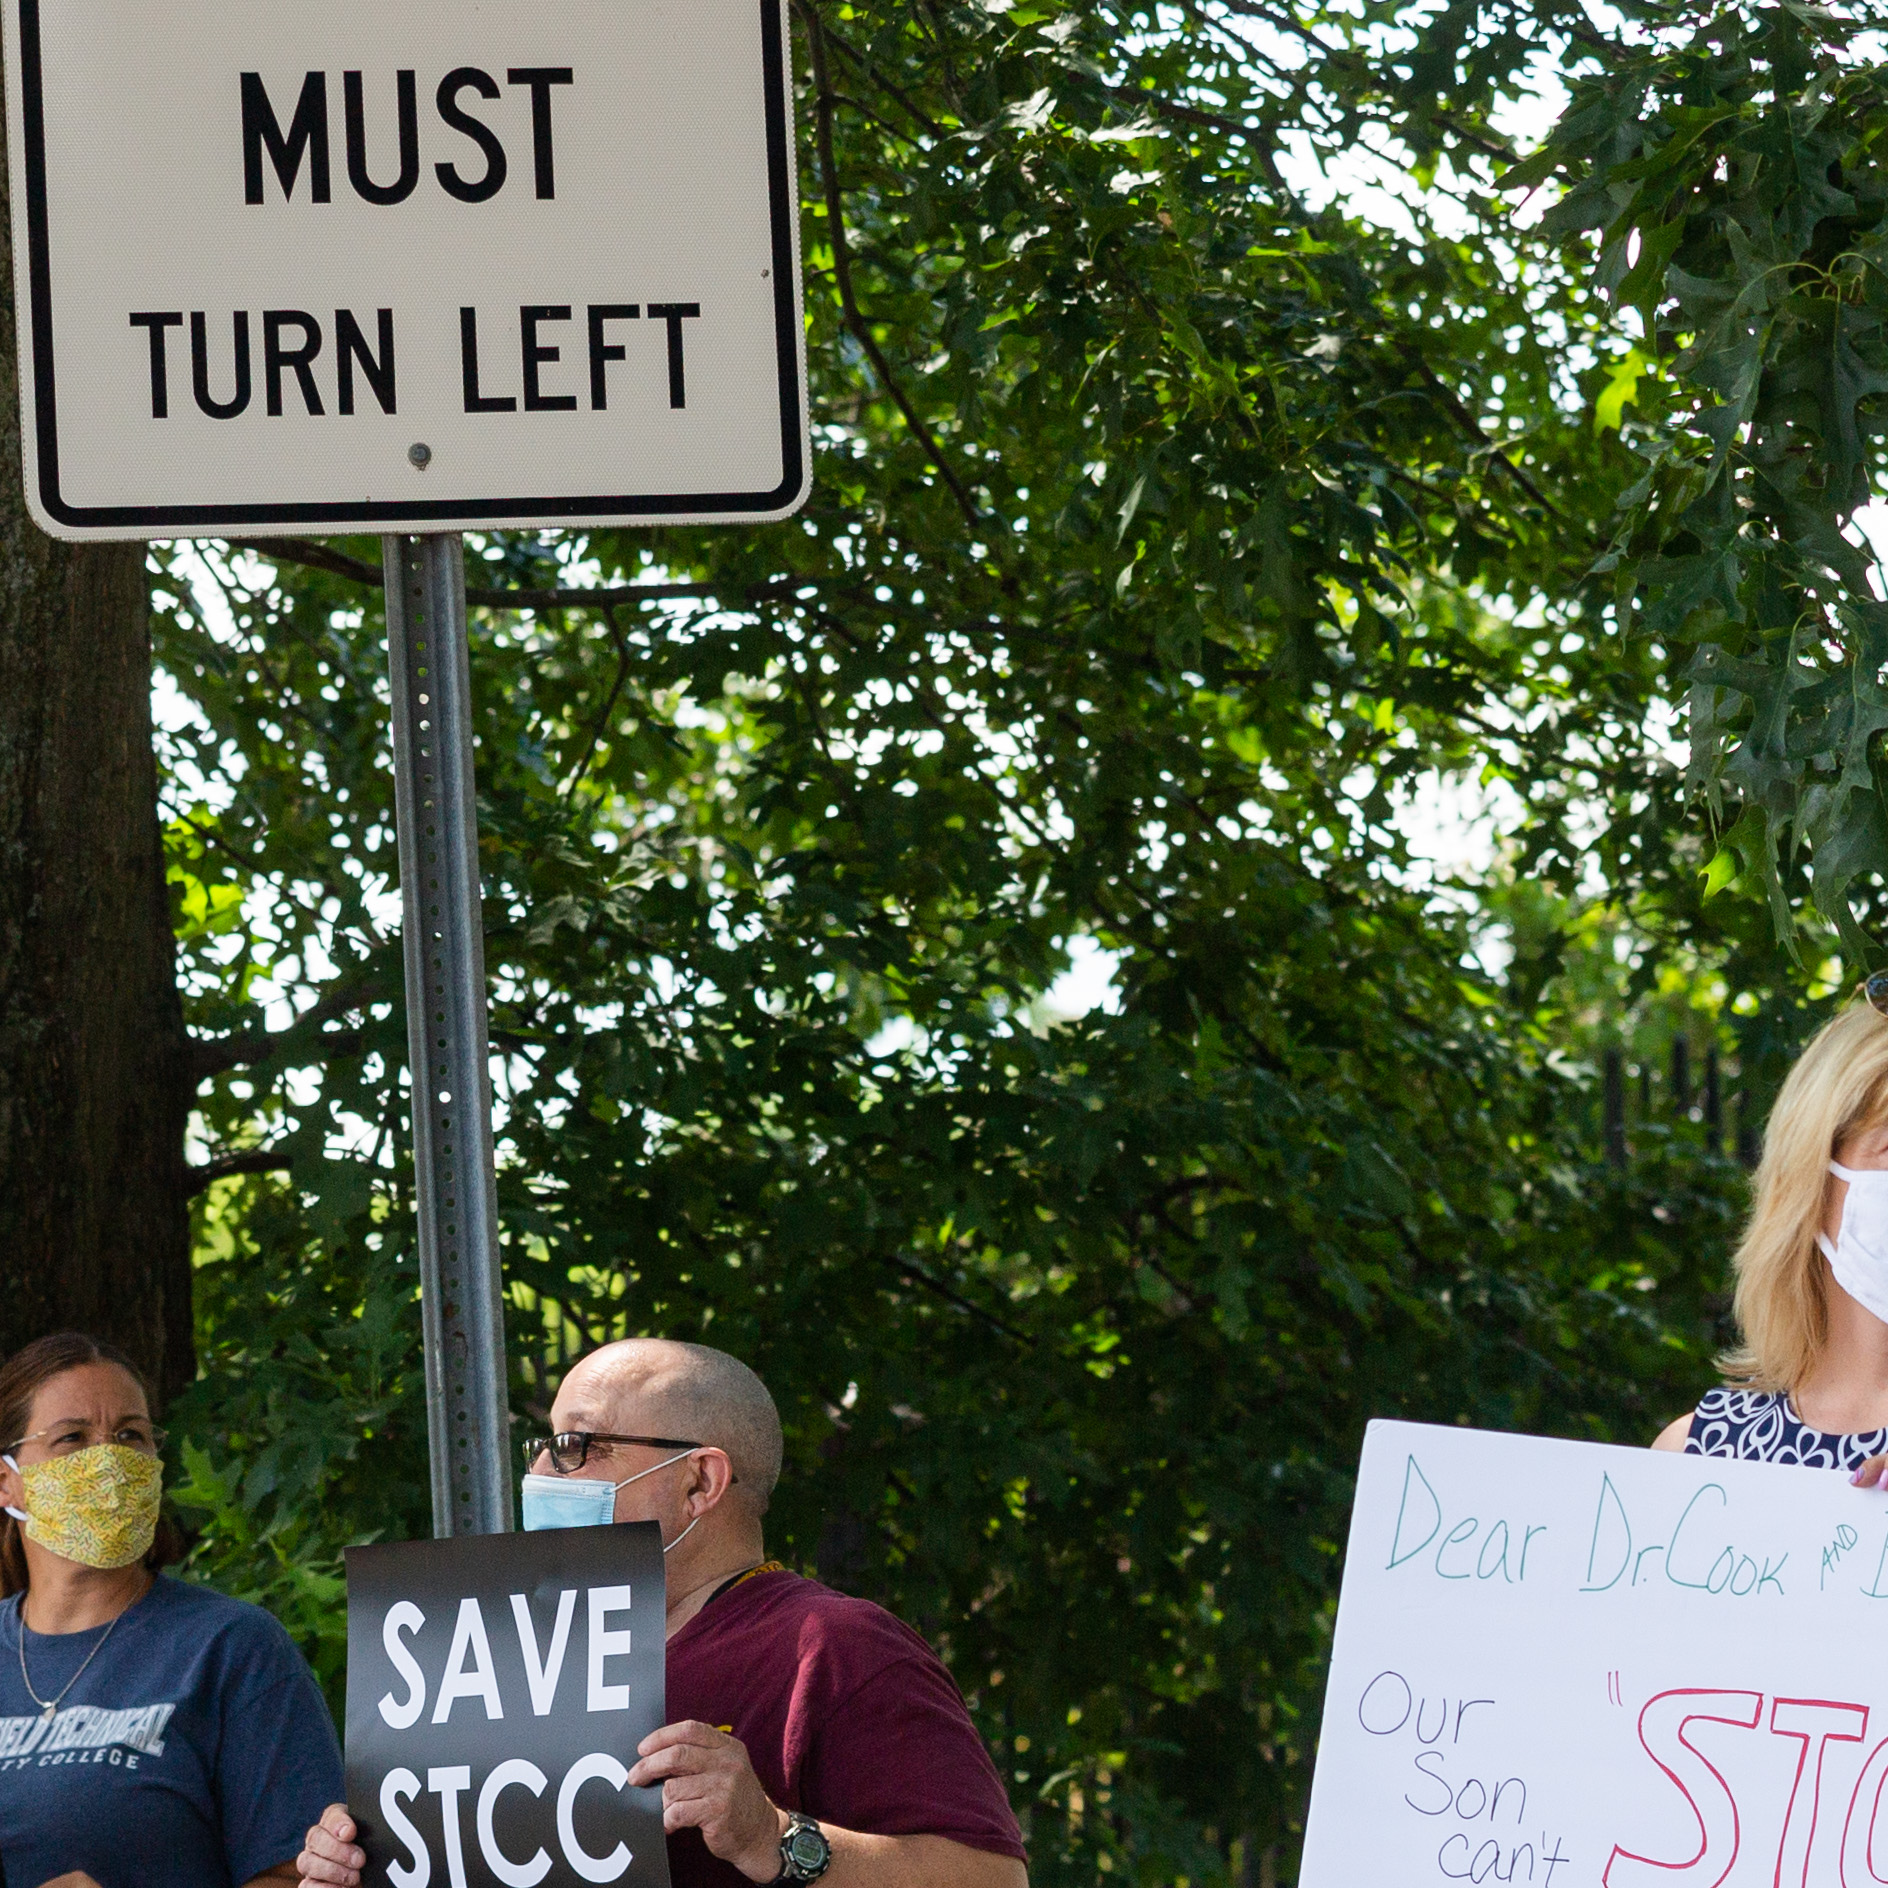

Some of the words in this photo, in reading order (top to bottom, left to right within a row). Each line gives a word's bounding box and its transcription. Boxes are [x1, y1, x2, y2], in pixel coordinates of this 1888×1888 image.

[240, 67, 573, 205] MUST
[129, 308, 396, 419] TURN
[460, 303, 700, 413] LEFT
[1385, 1454, 1547, 1583] Dear
[1821, 1523, 1858, 1591] AND
[378, 1585, 631, 1729] SAVE
[1359, 1671, 1495, 1744] Our
[37, 1747, 140, 1770] COLLEGE
[1405, 1751, 1526, 1824] Son
[1438, 1831, 1570, 1888] can't
